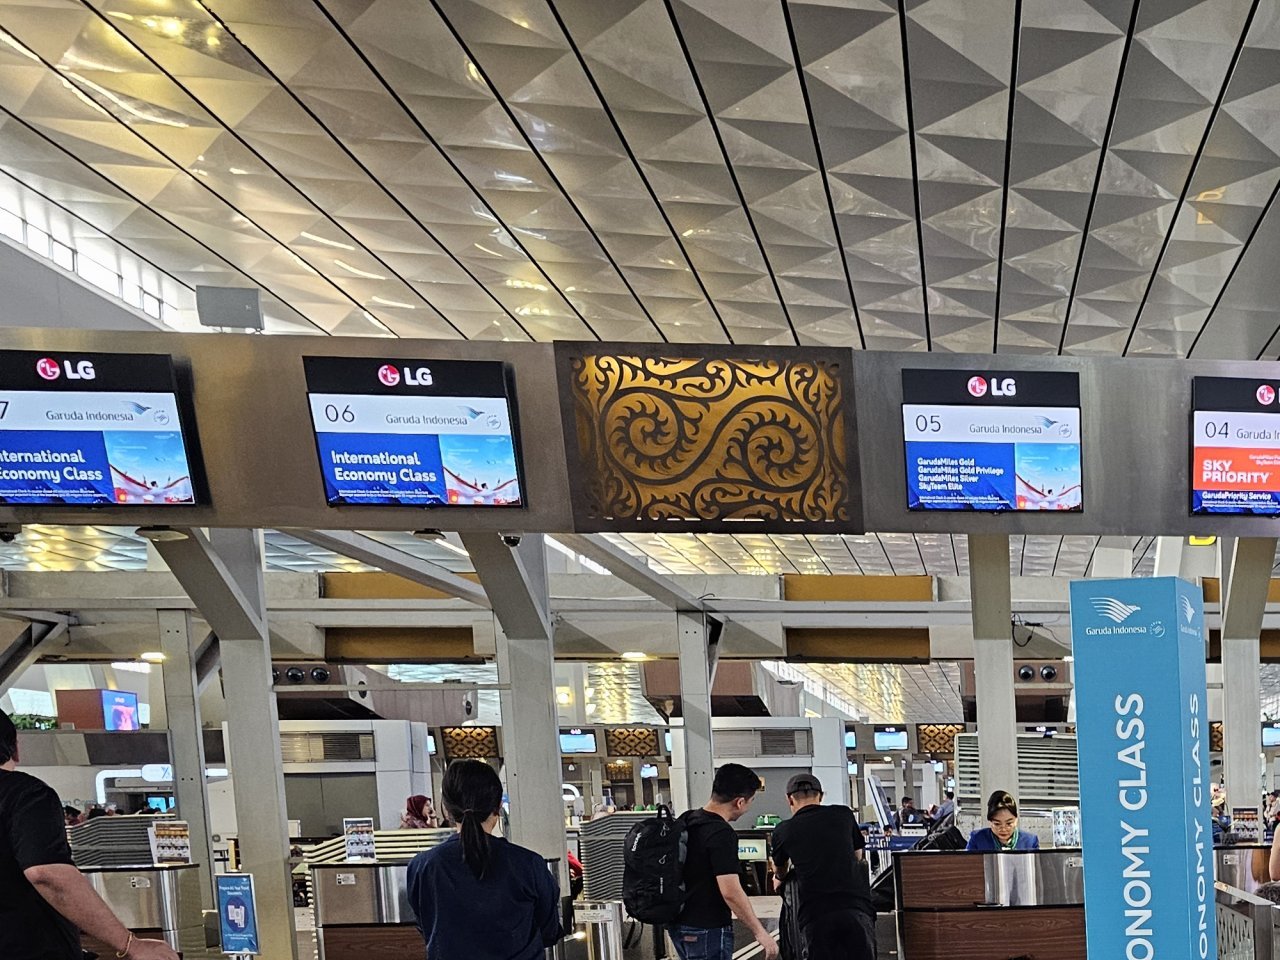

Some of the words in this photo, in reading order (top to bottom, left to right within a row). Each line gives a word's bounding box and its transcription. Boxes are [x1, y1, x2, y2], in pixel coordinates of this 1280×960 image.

[63, 360, 96, 380] LG
[403, 367, 433, 386] LG
[990, 378, 1017, 396] LG
[46, 410, 84, 421] Garuda
[86, 411, 134, 421] Indonesia
[325, 404, 355, 422] 06
[385, 414, 421, 425] Garuda
[423, 415, 468, 426] Indonesia
[915, 415, 942, 433] 05
[969, 424, 1000, 434] Garuda
[1002, 425, 1042, 435] Indonesia
[1205, 422, 1229, 439] 04
[1236, 428, 1272, 440] Garuda
[331, 450, 421, 465] International
[917, 457, 958, 466] GarudaMiles
[917, 466, 958, 474] GarudaMiles
[1203, 459, 1232, 471] SKY
[63, 467, 103, 481] Class
[335, 467, 396, 484] Economy
[400, 469, 437, 482] Class
[918, 474, 959, 482] GarudaMiles
[1202, 470, 1270, 484] PRIORITY
[1202, 491, 1248, 502] GarudaPriority
[1249, 492, 1271, 500] Service
[1086, 626, 1112, 636] Garuda
[1113, 625, 1147, 635] Indonesia
[1114, 692, 1148, 812] CLASS
[1190, 693, 1202, 808] CLASS
